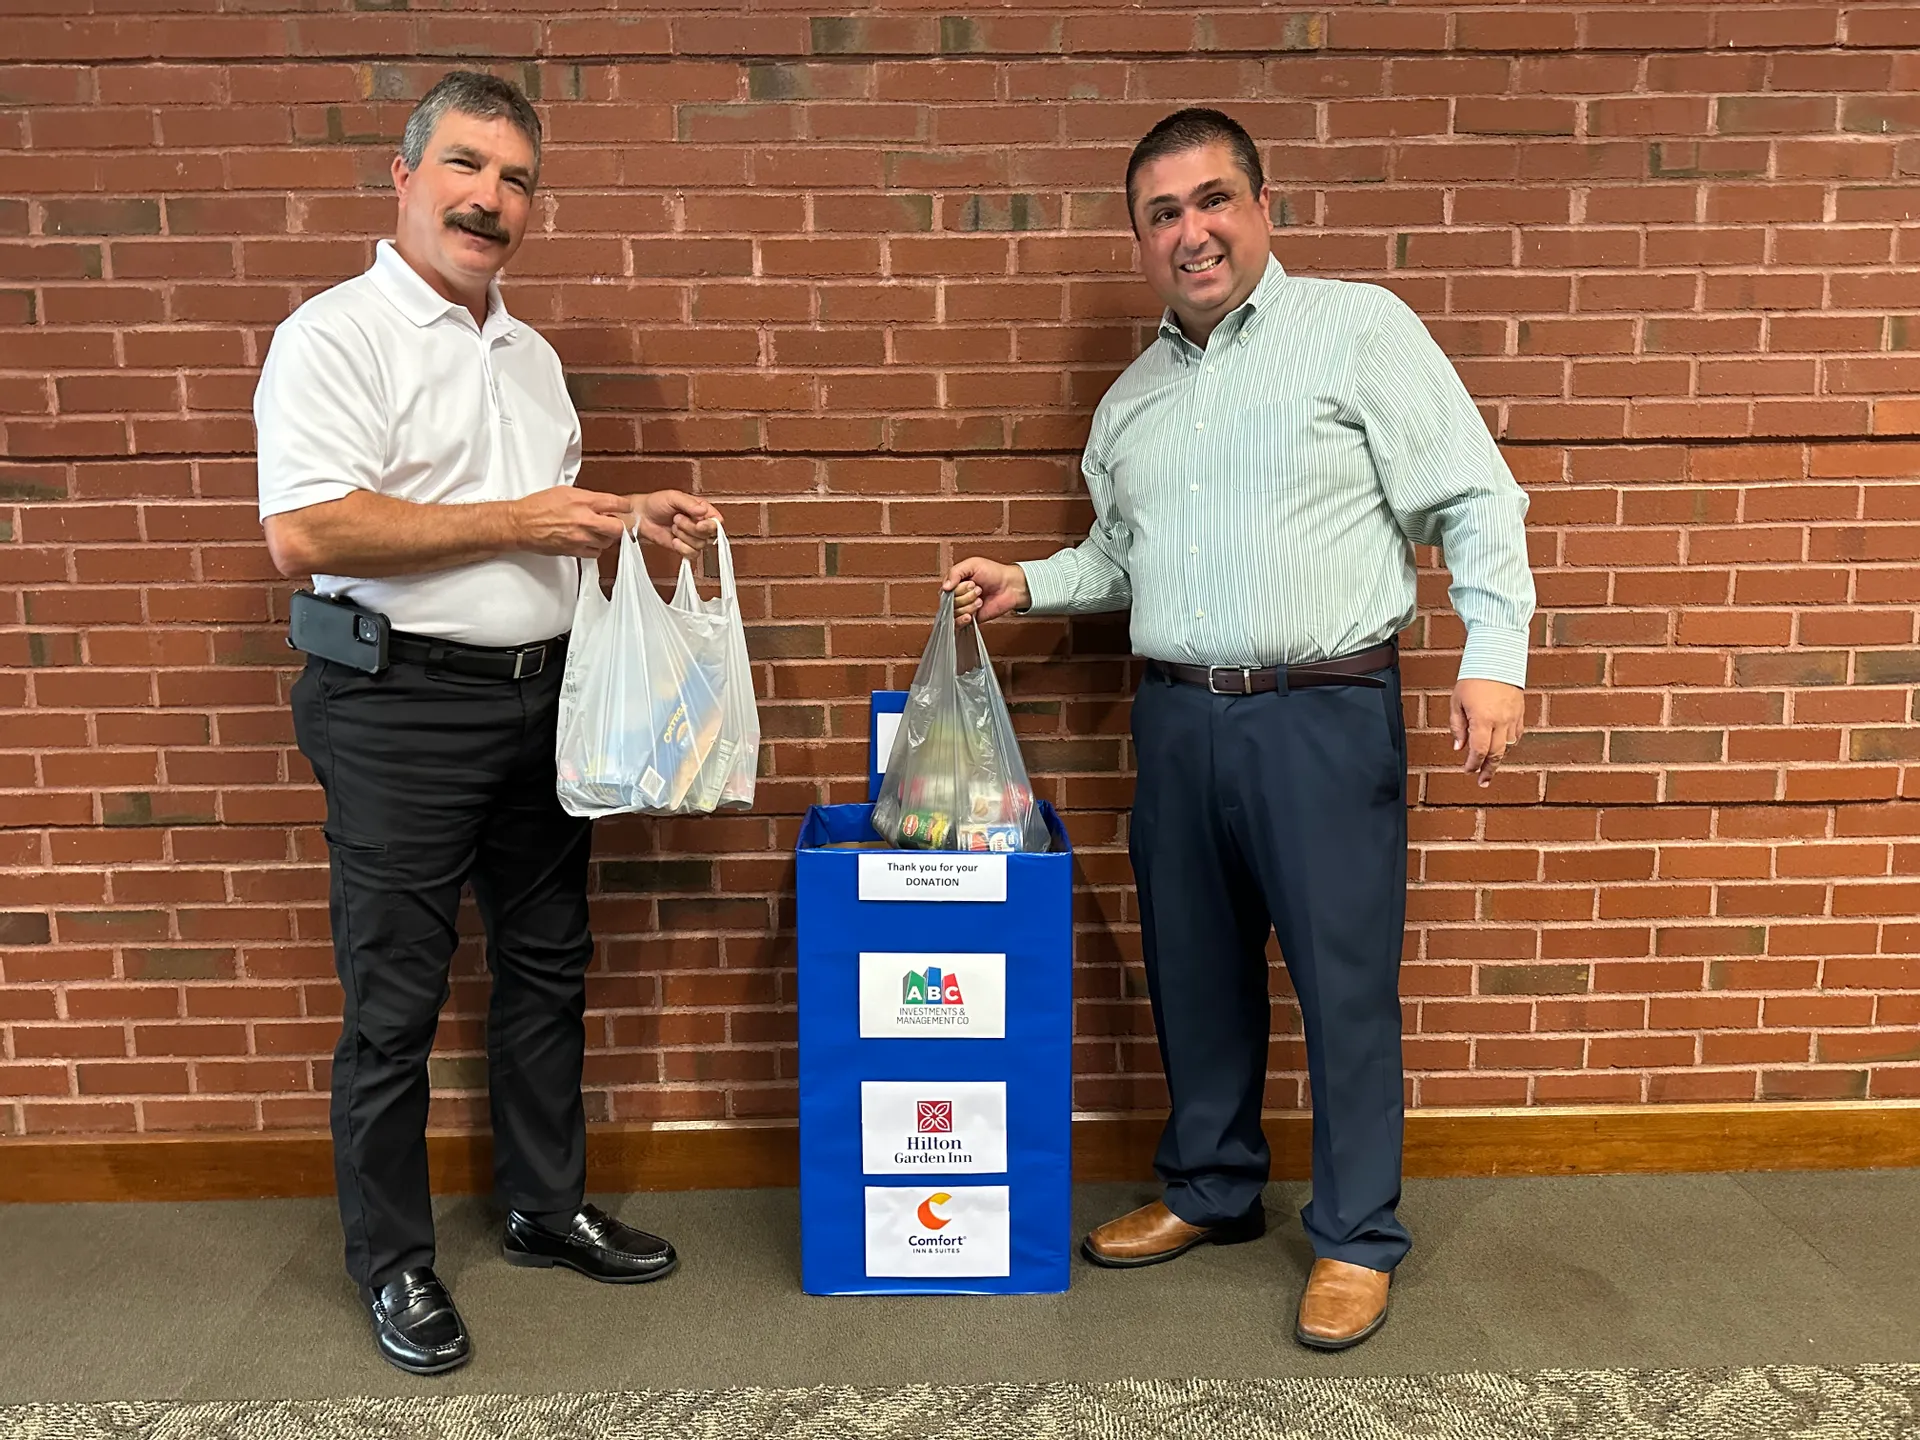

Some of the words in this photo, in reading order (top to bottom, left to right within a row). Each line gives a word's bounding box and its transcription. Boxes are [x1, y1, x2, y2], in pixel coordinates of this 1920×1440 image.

[887, 862, 917, 872] Thank
[919, 864, 937, 874] you
[940, 862, 954, 872] for
[956, 864, 979, 874] your
[905, 877, 960, 887] DONATION
[907, 985, 960, 1001] ABC
[899, 1007, 958, 1016] INVESTMENTS
[958, 1007, 966, 1016] &
[896, 1016, 956, 1025] MANAGEMENT
[957, 1016, 970, 1025] CO
[907, 1136, 962, 1150] Hilton
[894, 1152, 946, 1164] Garden
[948, 1152, 973, 1164] Inn
